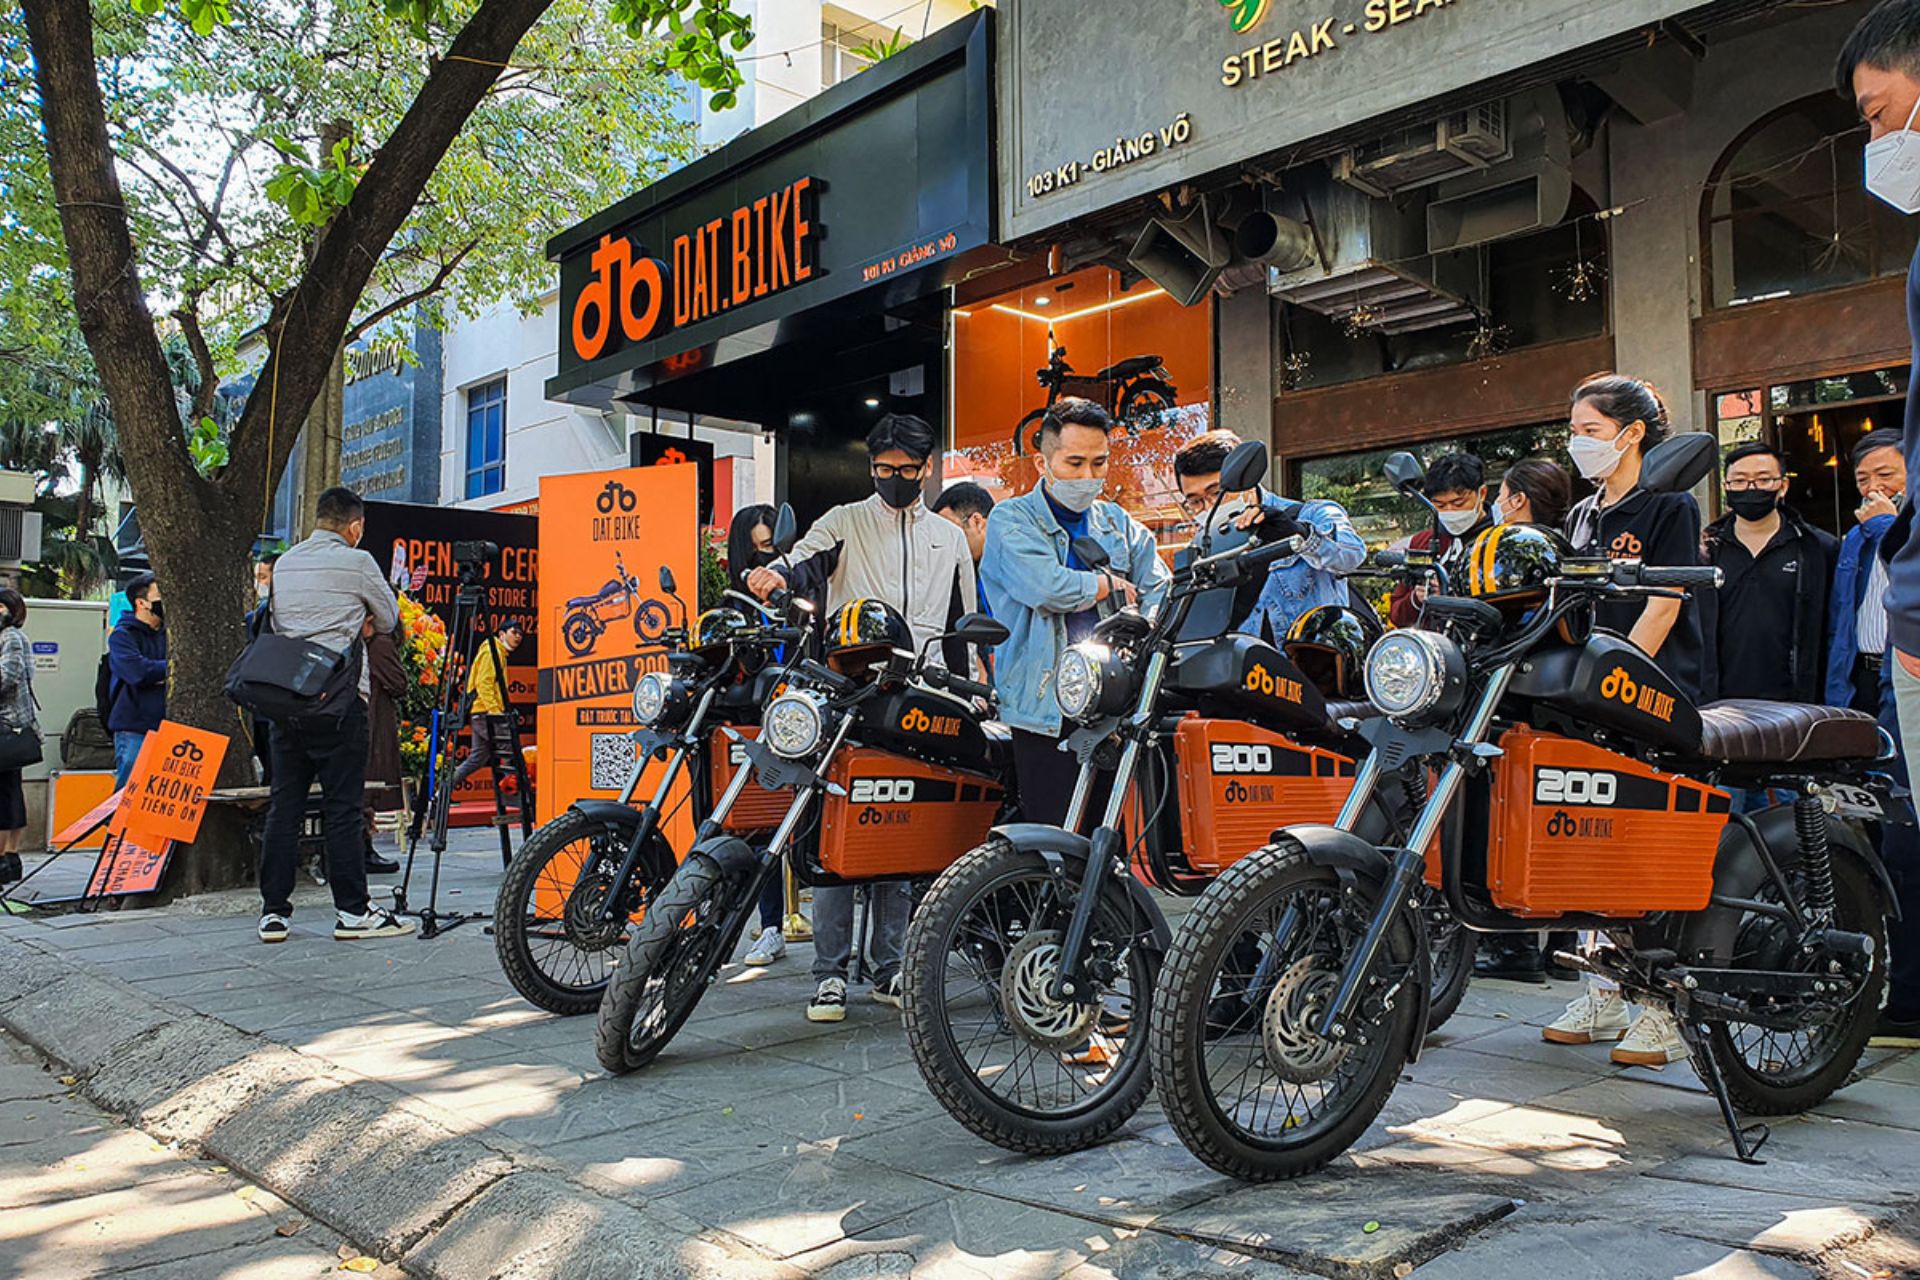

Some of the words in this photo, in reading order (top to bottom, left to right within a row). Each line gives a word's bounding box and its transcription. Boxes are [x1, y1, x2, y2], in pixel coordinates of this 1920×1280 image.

[1221, 17, 1337, 87] STEAK
[1026, 171, 1053, 197] 103
[1057, 160, 1079, 187] K1
[1092, 132, 1156, 173] GIẢNG
[1160, 112, 1190, 148] VÕ
[673, 176, 812, 328] DAT.BIKE
[862, 263, 880, 282] 101
[881, 257, 896, 274] K1
[593, 514, 641, 541] DAT.BIKE
[426, 584, 451, 604] DAT
[488, 587, 528, 608] STORE
[557, 662, 630, 699] WEAVER
[1211, 744, 1273, 773] 200
[851, 779, 915, 803] 200
[1536, 769, 1617, 805] 200
[1835, 788, 1877, 807] 18
